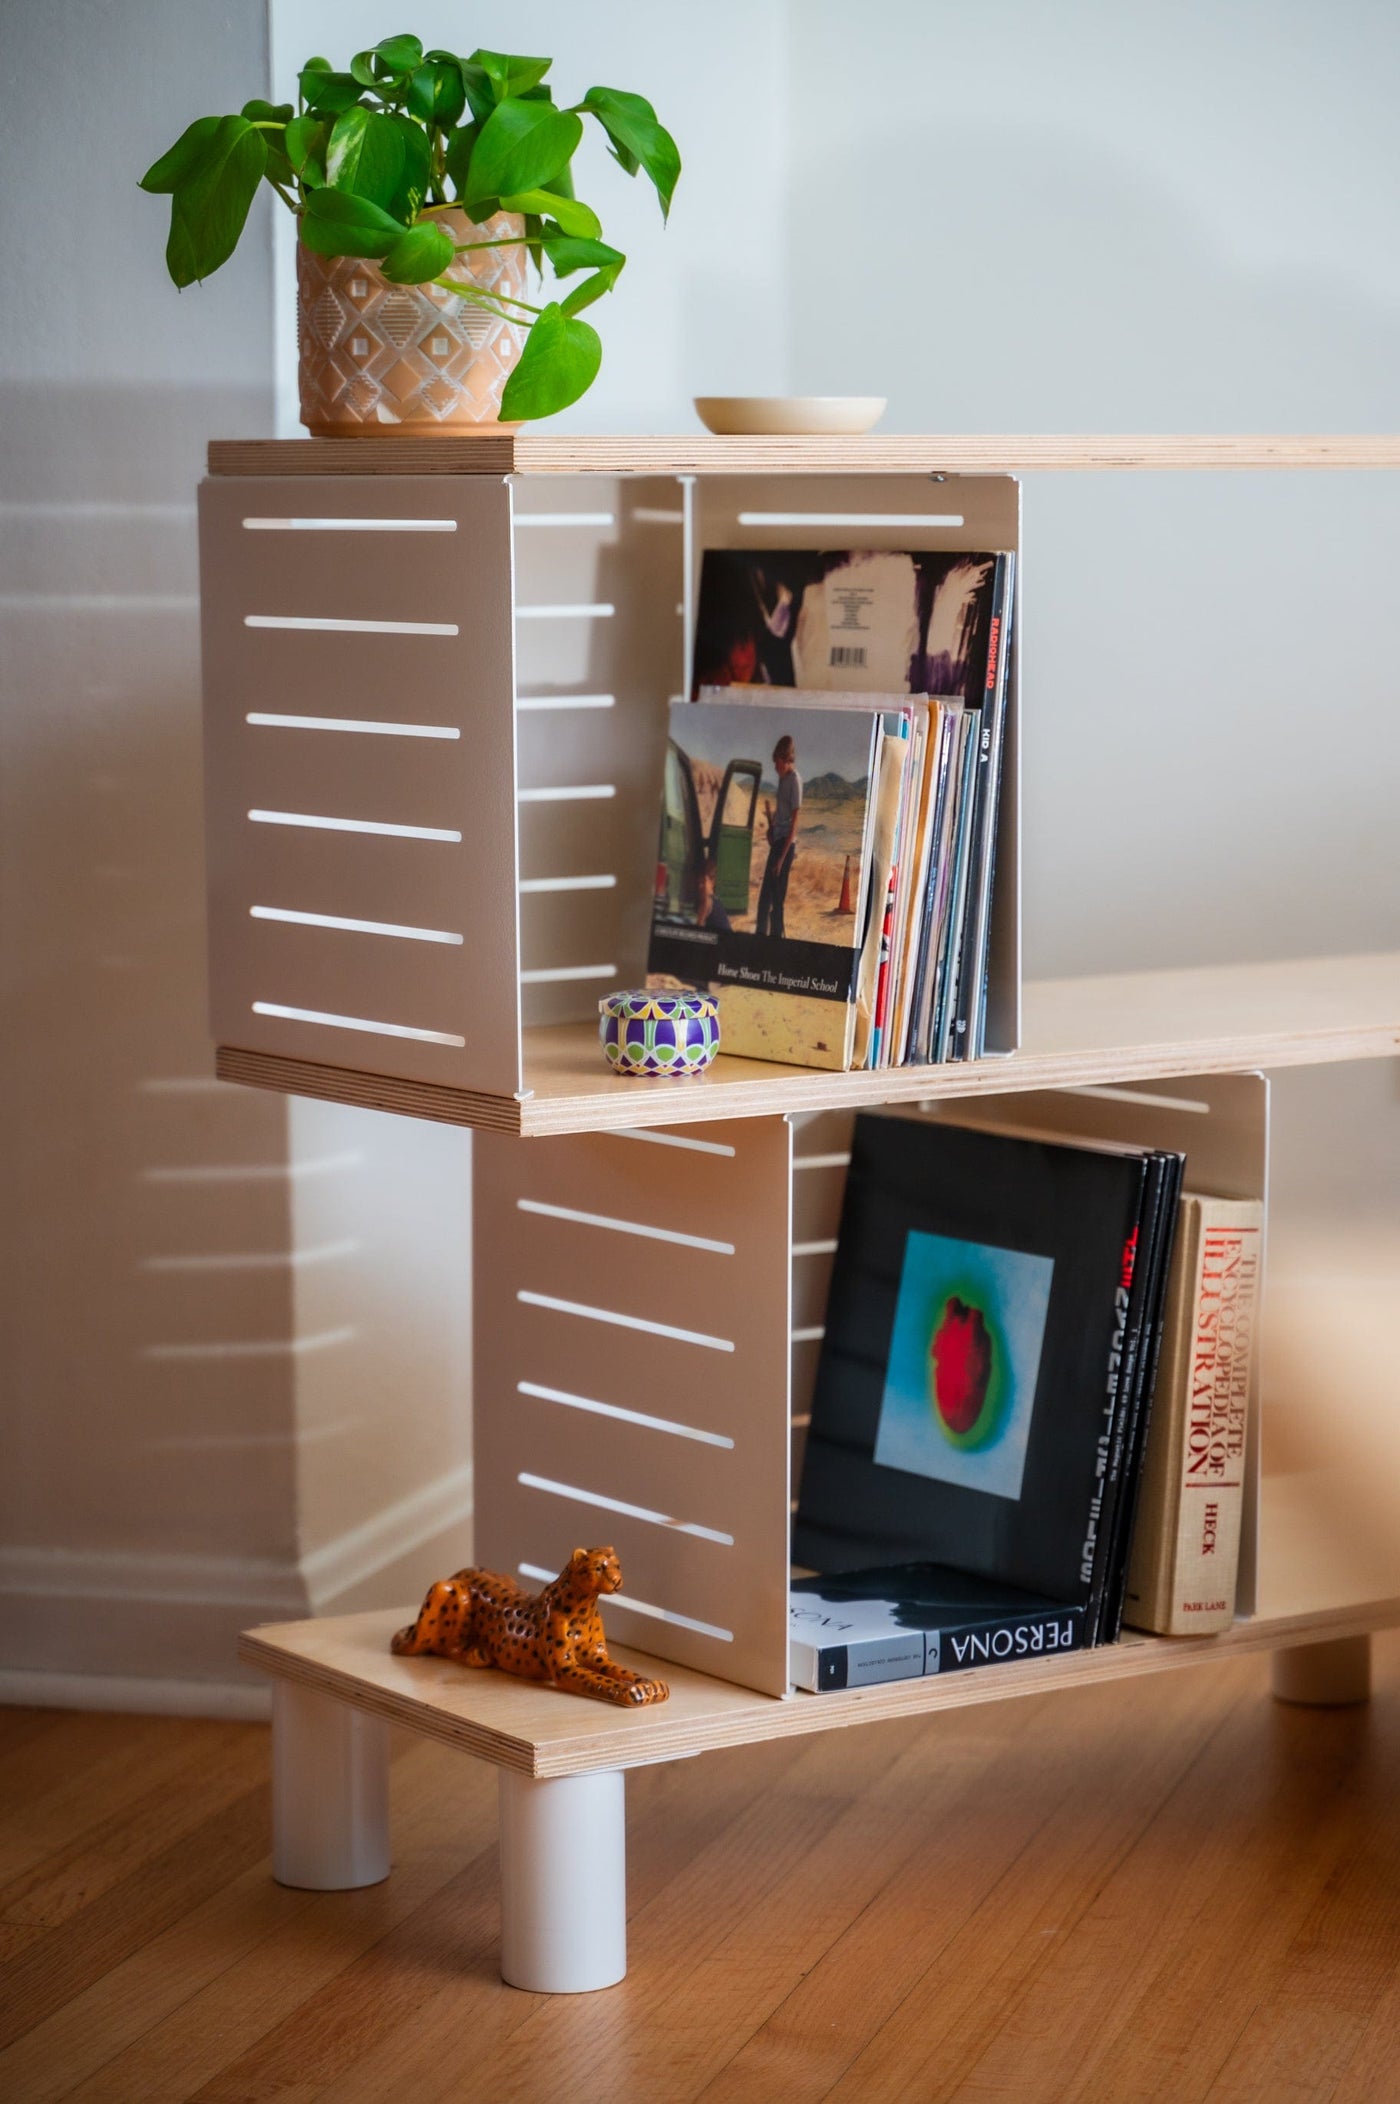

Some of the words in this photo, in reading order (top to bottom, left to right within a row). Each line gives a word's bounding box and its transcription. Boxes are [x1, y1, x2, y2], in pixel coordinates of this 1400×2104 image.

[986, 617, 1000, 689] RADIOHEAD
[980, 754, 989, 763] A
[981, 728, 991, 750] KID
[762, 970, 777, 984] The
[778, 972, 810, 990] Imperial
[811, 977, 838, 993] School
[1238, 1253, 1258, 1307] THE
[1187, 1239, 1225, 1476] ILLUSTRATION
[1211, 1239, 1242, 1439] ENCYCLOPEDIA
[1227, 1314, 1252, 1459] COMPLETE
[1208, 1441, 1226, 1478] OF
[1202, 1503, 1219, 1556] HECK
[1183, 1602, 1204, 1613] PARK
[1205, 1601, 1227, 1611] LANE
[951, 1619, 1074, 1663] PERSONA
